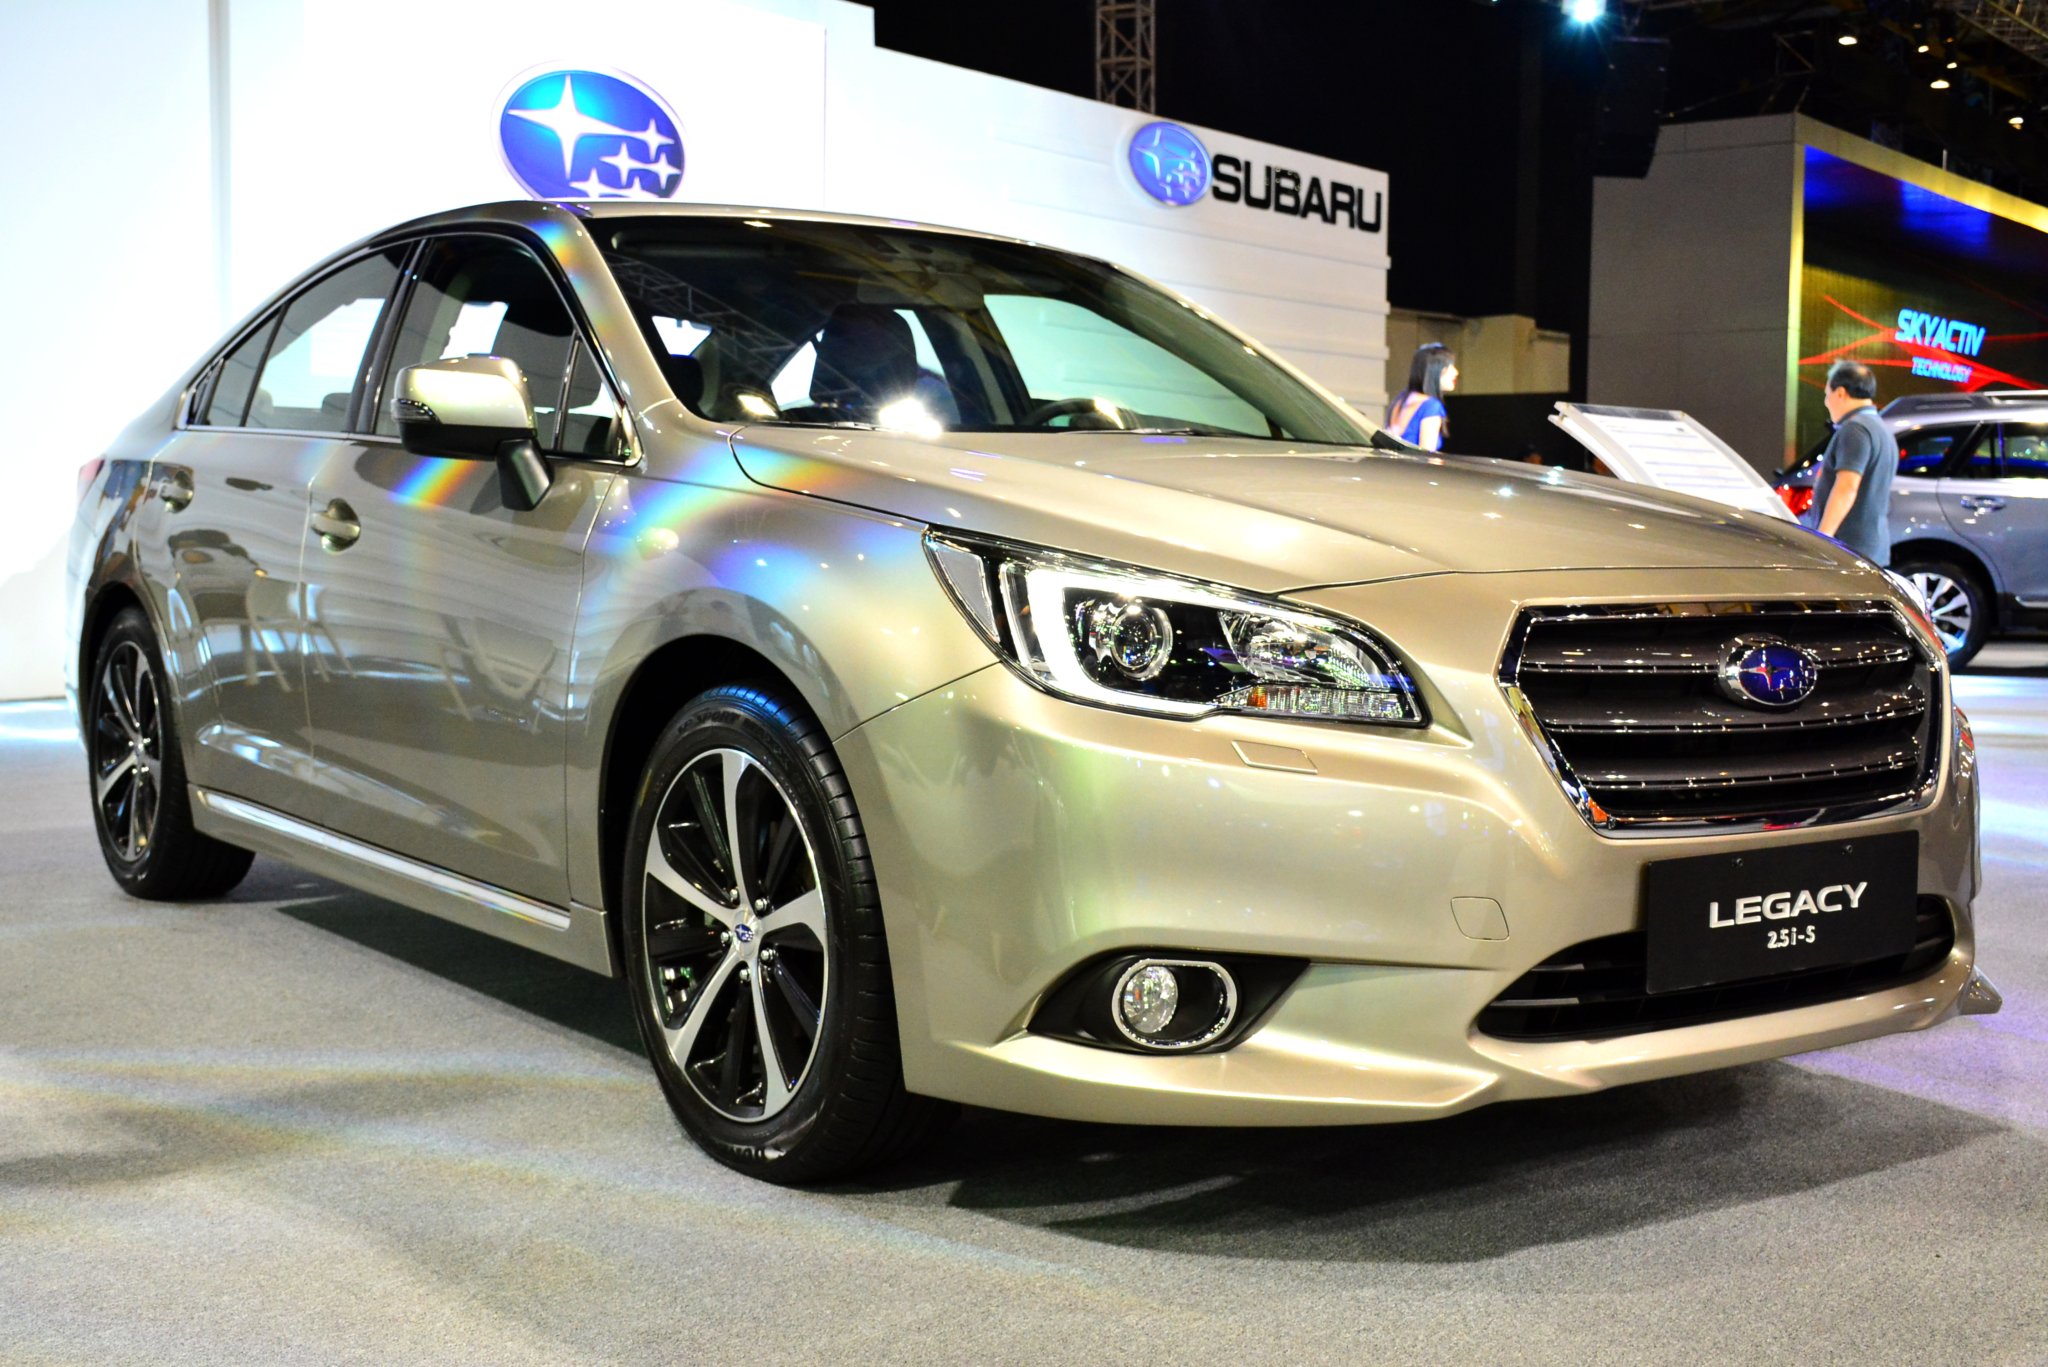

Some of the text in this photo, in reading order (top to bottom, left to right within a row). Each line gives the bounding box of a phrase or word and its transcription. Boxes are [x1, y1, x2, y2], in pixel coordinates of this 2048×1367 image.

[1211, 153, 1382, 233] SUBARU
[1895, 308, 1986, 357] SKYACTIV
[1911, 356, 1973, 384] TECHNOLOGY
[1709, 881, 1868, 928] LEGACY
